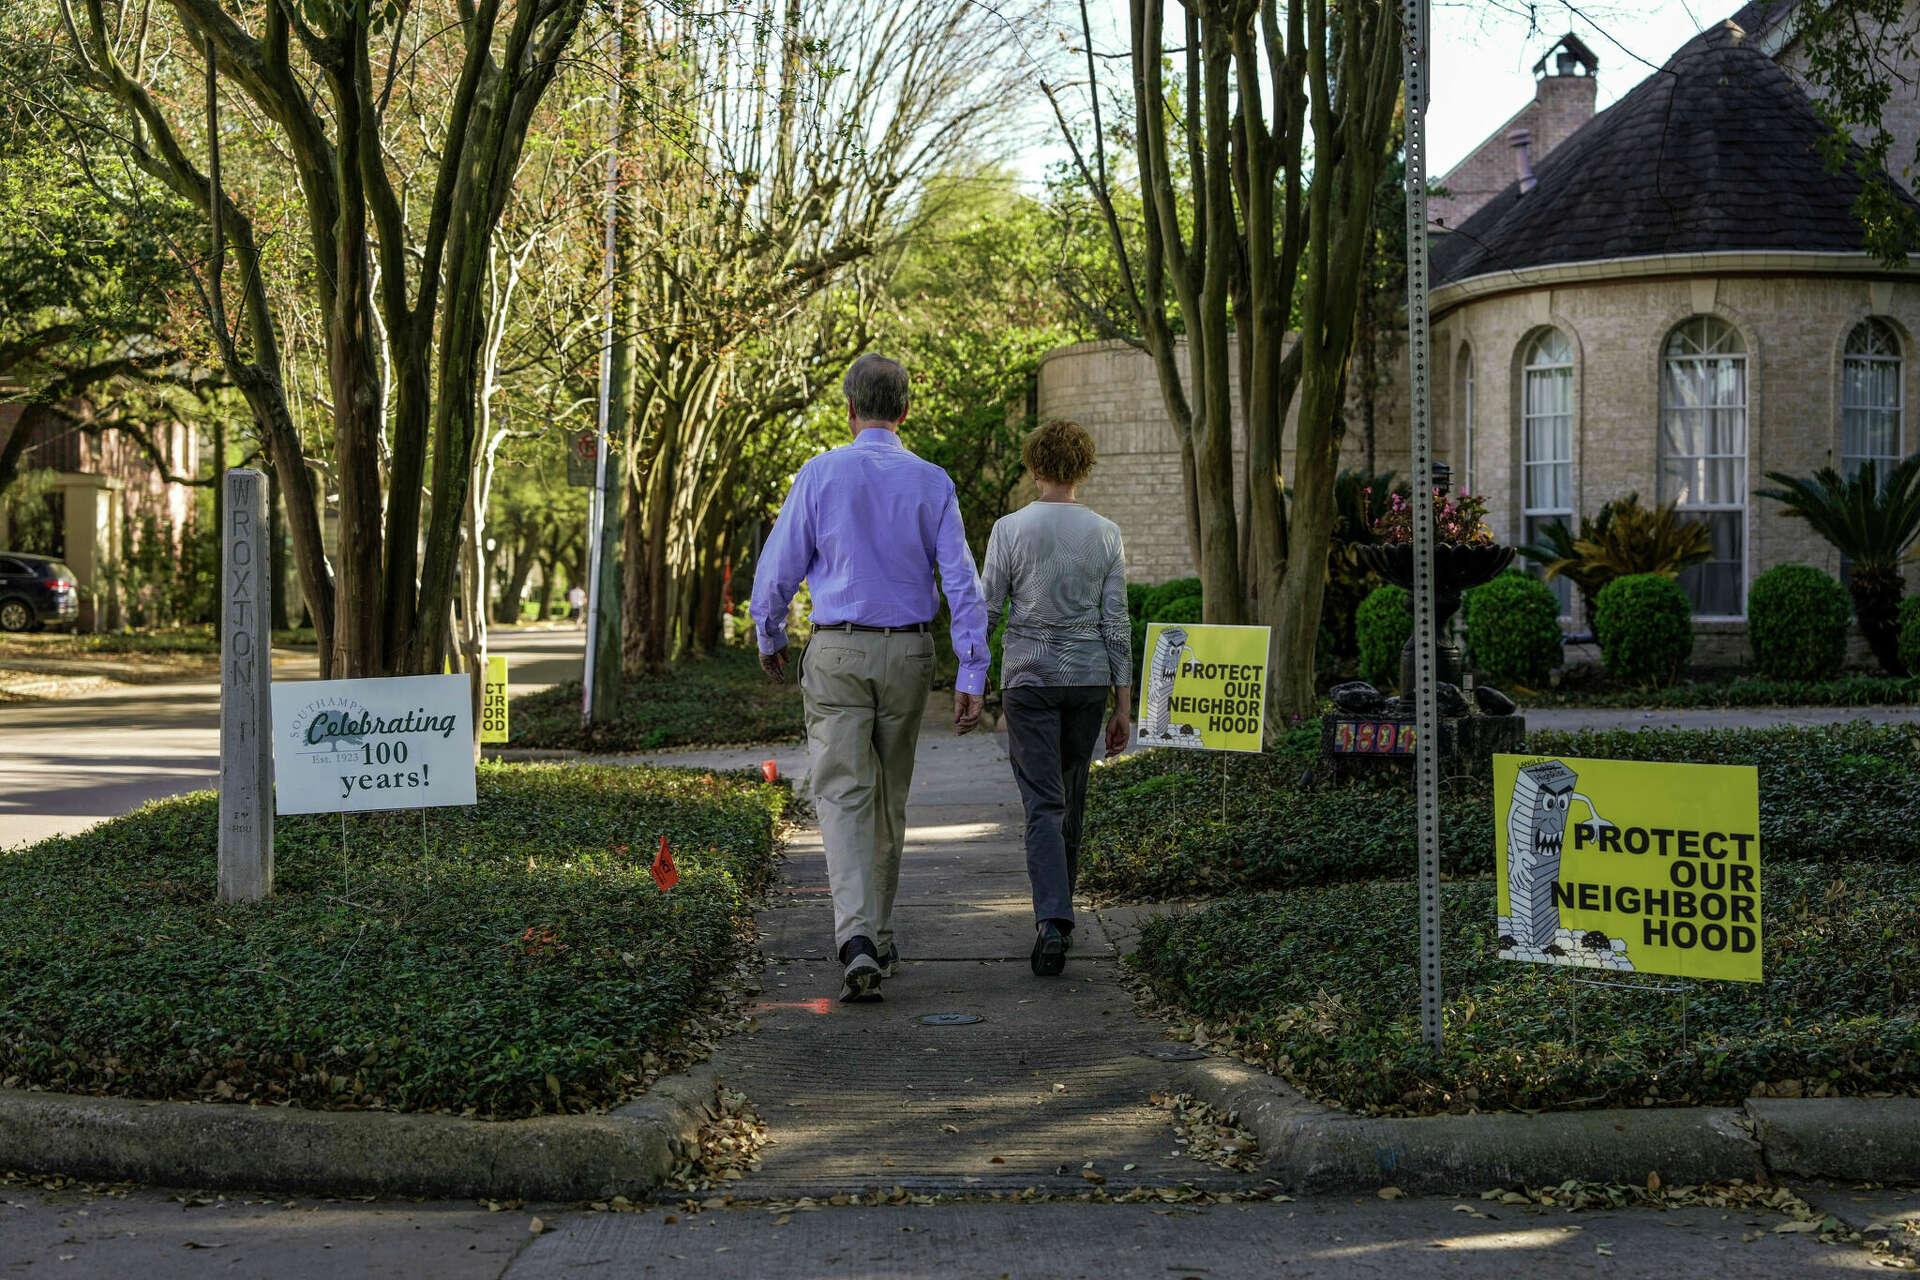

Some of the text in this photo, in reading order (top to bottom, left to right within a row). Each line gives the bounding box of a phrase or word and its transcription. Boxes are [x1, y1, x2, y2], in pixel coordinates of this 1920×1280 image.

[232, 478, 251, 686] WROXTON
[1181, 663, 1263, 681] PROTECT
[485, 696, 505, 706] UR
[1224, 682, 1261, 699] OUR
[290, 697, 374, 738] SOUTHAMPT
[1167, 696, 1260, 717] NEIGHBOR
[307, 708, 456, 745] Celebrating
[483, 720, 505, 731] OD
[1209, 716, 1258, 734] HOOD
[312, 753, 359, 764] Est. 1923
[361, 741, 408, 765] 100
[340, 764, 430, 799] years!
[1574, 823, 1755, 861] PROTECT
[1670, 860, 1756, 892] OUR
[1550, 881, 1756, 923] NEIGHBOR
[1643, 918, 1756, 953] HOOD
